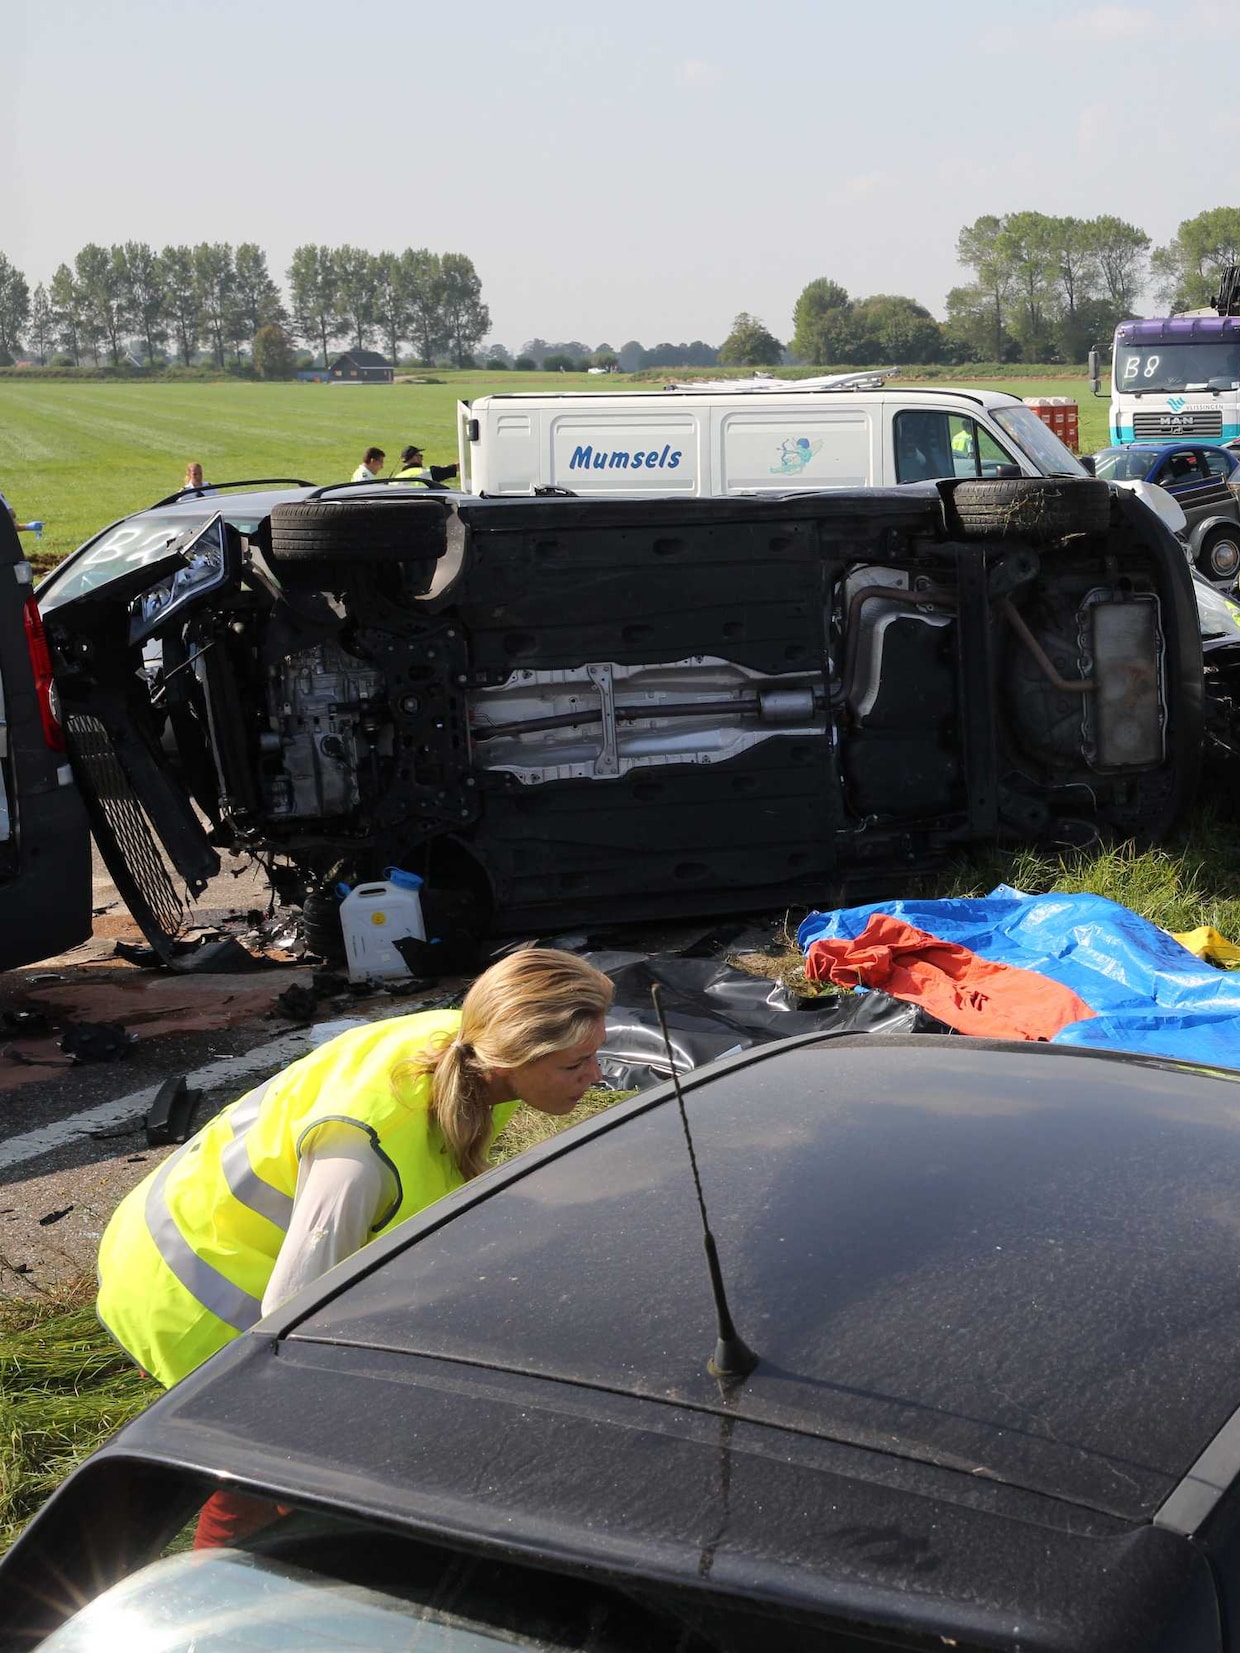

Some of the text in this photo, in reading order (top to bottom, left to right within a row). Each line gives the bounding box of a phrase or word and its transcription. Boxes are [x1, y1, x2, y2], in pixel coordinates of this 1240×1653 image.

[1123, 355, 1160, 379] B8
[1160, 417, 1195, 425] MAN
[569, 444, 683, 470] Mumsels
